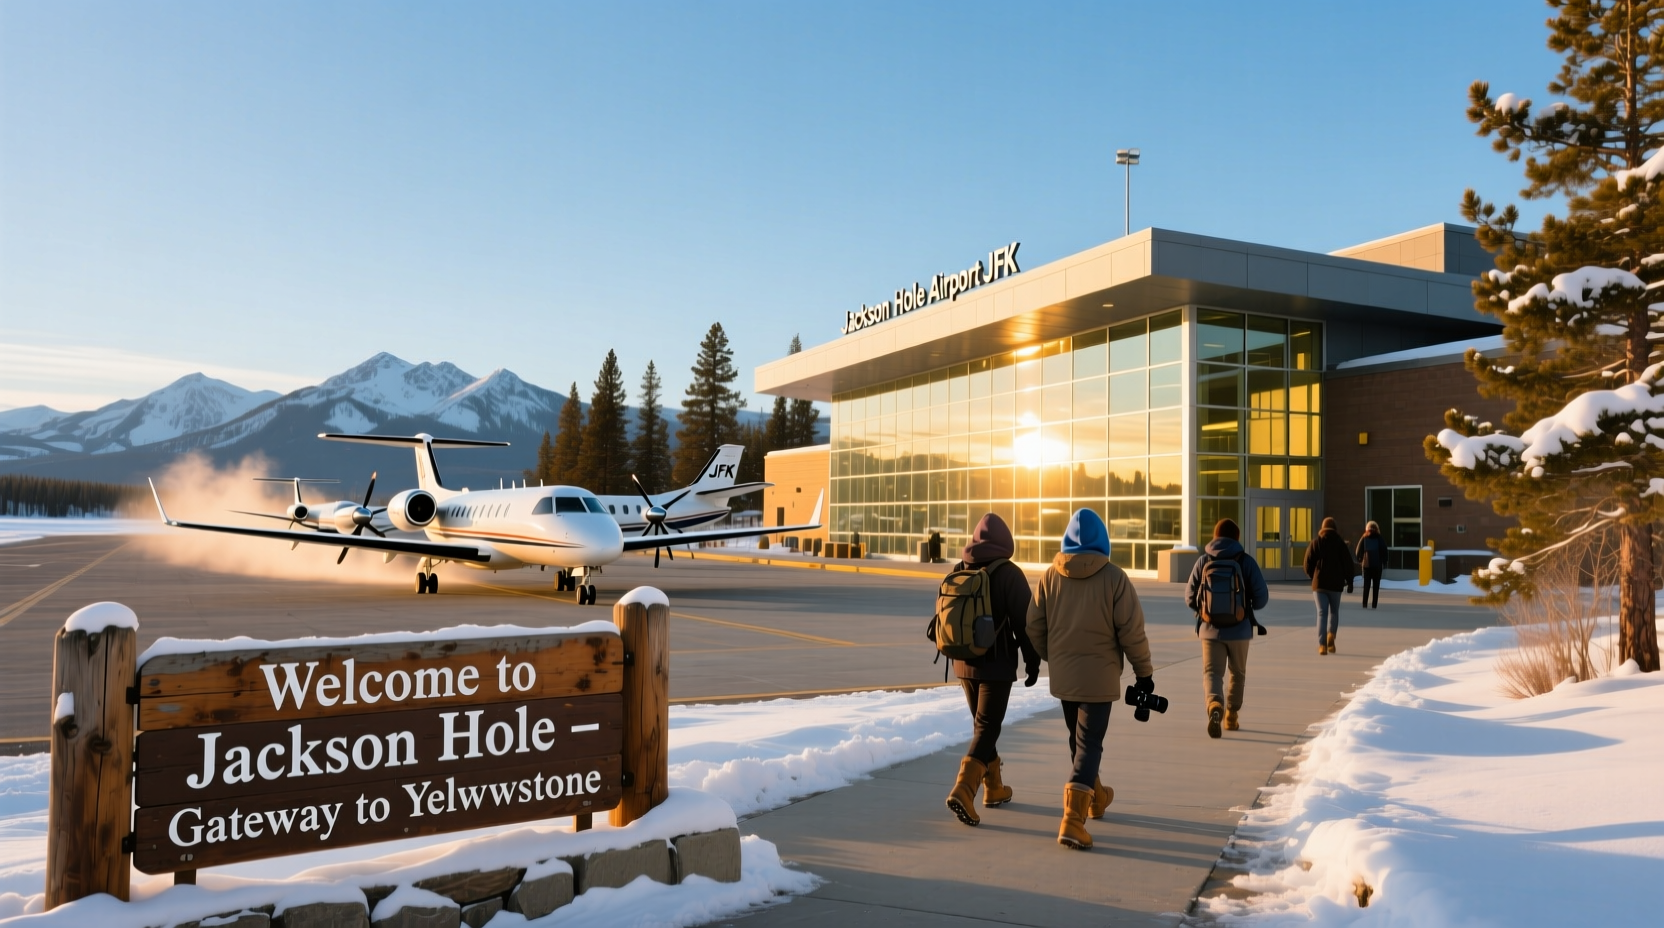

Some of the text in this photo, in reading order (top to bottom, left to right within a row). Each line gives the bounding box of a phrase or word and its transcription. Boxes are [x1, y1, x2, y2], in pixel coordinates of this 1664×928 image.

[840, 241, 1020, 334] Jackson Hole Airport JFK
[708, 463, 735, 479] JFK
[259, 656, 537, 711] Welcome to
[186, 723, 418, 789] Jackson
[437, 705, 555, 762] Hole
[168, 770, 602, 848] Gateway to Yelwwstone
